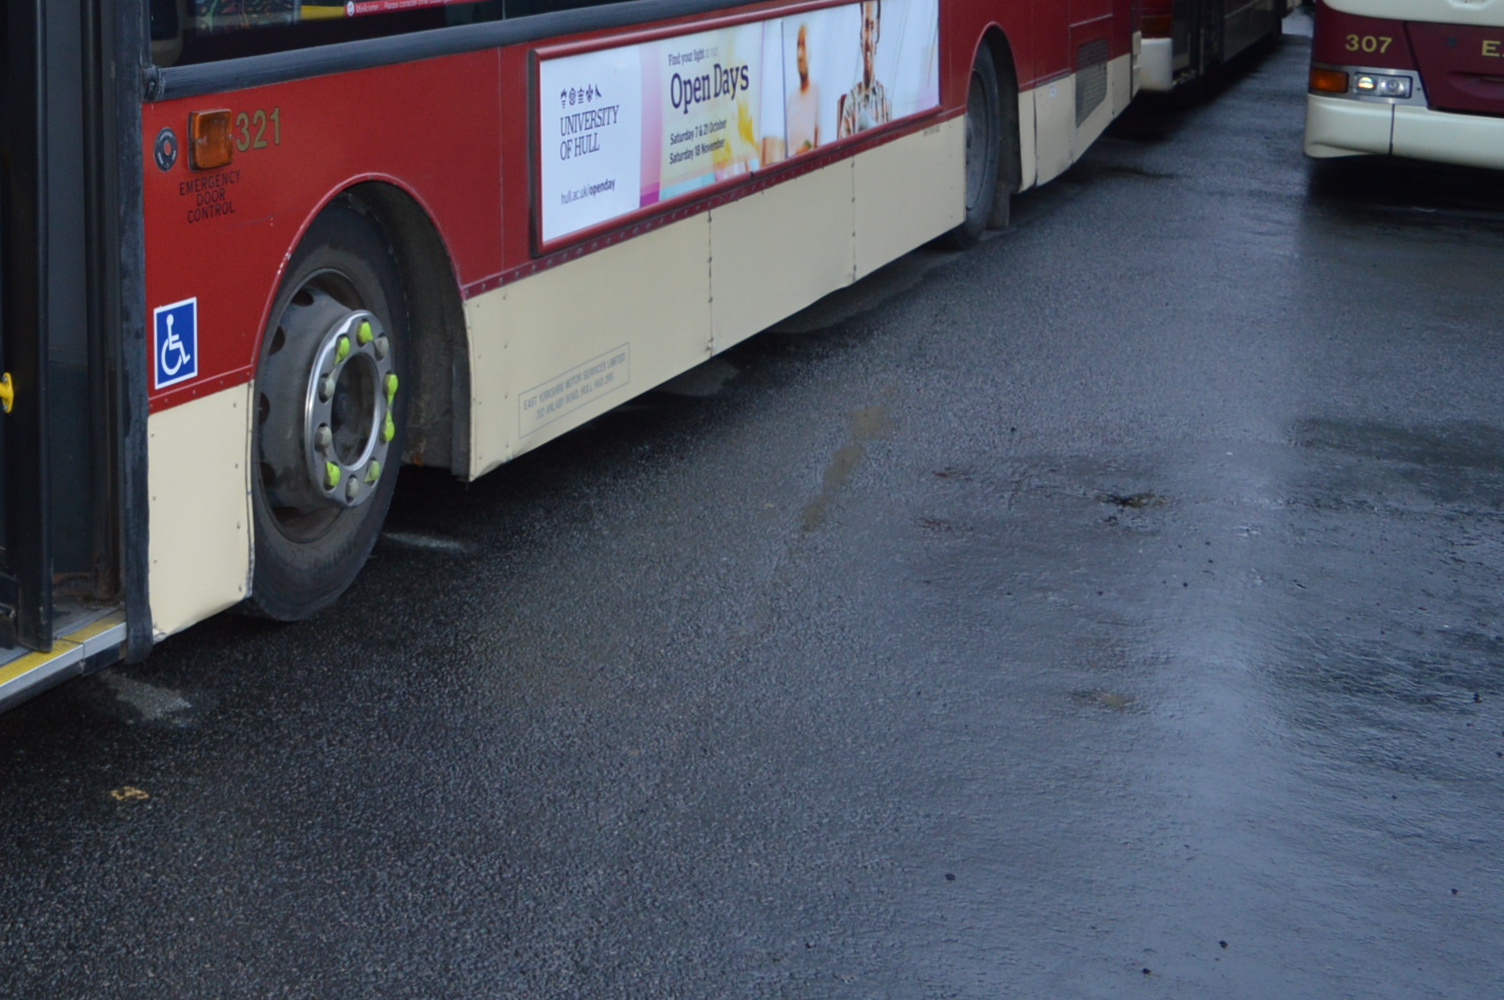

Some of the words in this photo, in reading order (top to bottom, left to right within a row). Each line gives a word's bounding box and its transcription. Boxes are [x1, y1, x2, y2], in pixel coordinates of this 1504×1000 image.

[668, 51, 681, 66] Find
[681, 51, 693, 66] your
[693, 47, 705, 62] light
[1345, 34, 1393, 54] 307
[670, 72, 712, 115] Open
[713, 63, 750, 101] Days
[236, 106, 280, 152] 321
[560, 104, 620, 137] UNIVERSITY
[669, 127, 695, 146] Saturday
[709, 119, 728, 134] October
[559, 138, 574, 161] OF
[574, 132, 601, 157] HULL
[669, 147, 695, 165] Saturday
[701, 138, 726, 155] November
[179, 169, 241, 196] EMERGENCY
[560, 178, 616, 206] hull.ac.uk/openday
[197, 187, 226, 207] DOOR
[187, 200, 236, 224] CONTROL
[523, 395, 538, 411] EAST
[538, 381, 565, 402] YORKSHIRE
[565, 372, 582, 389] MOTOR
[582, 361, 607, 380] SERVICES
[607, 352, 626, 369] LIMITED
